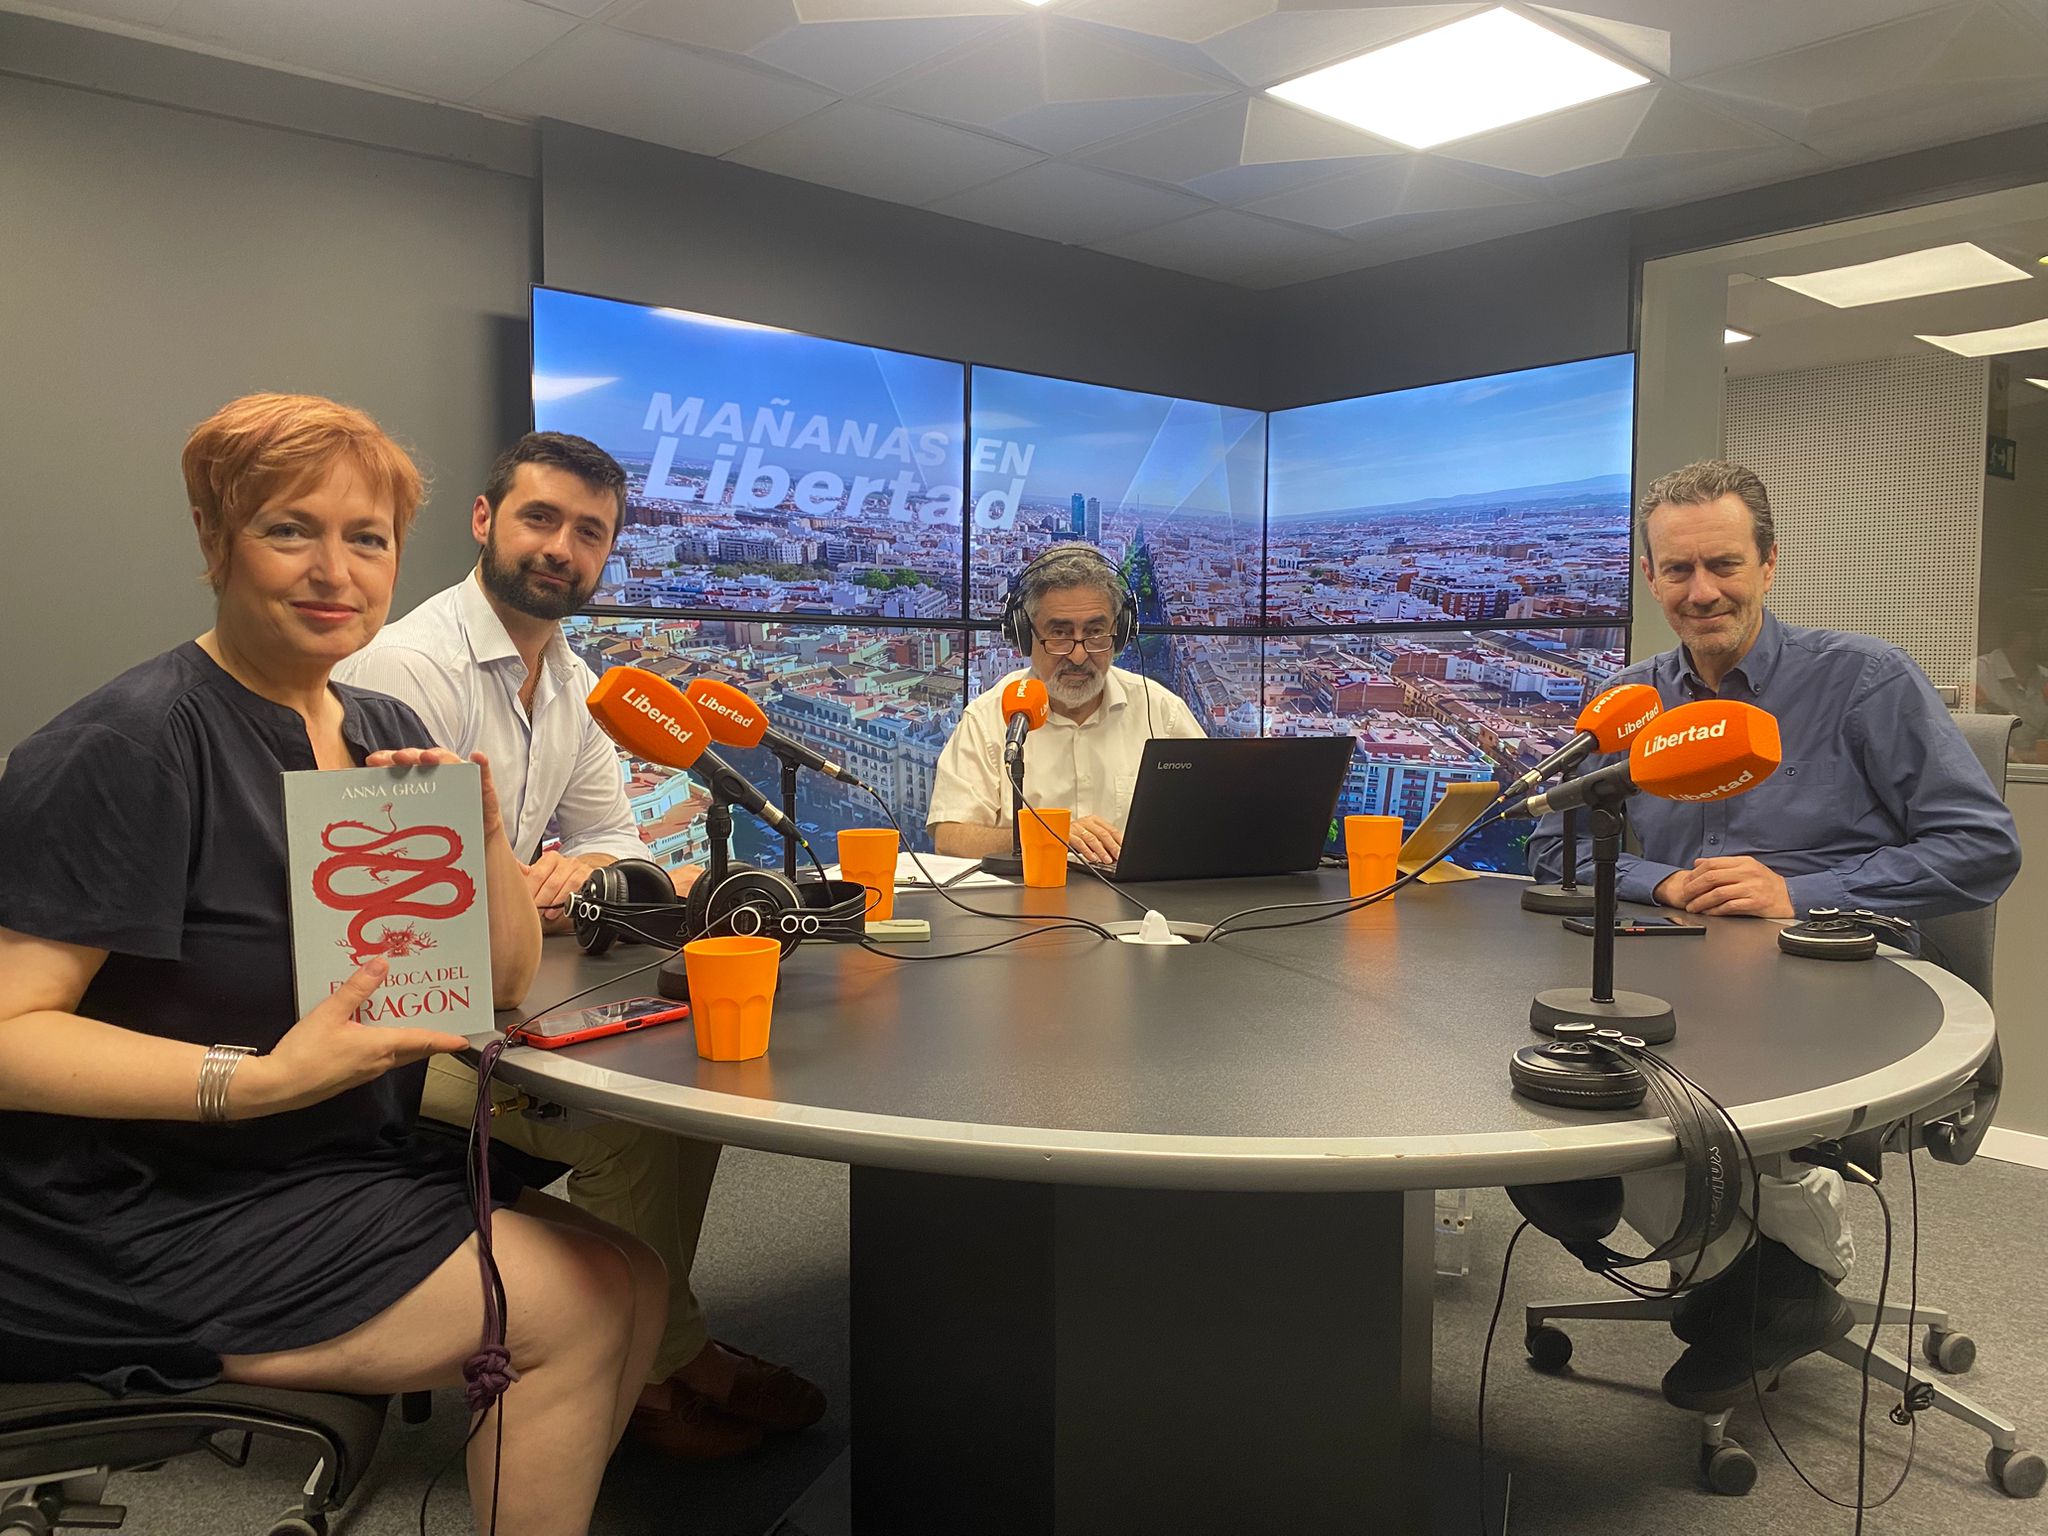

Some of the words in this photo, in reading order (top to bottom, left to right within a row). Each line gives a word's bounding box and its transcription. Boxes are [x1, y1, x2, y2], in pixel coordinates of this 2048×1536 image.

[643, 391, 949, 466] MAÑANAS
[972, 437, 1036, 476] EN
[643, 435, 1026, 531] Libertad
[622, 687, 693, 743] Libertad
[697, 693, 754, 728] Libertad
[1617, 702, 1659, 739] Libertad
[1643, 719, 1727, 757] Libertad
[1157, 761, 1193, 770] Lenovo
[341, 783, 387, 800] ANNA
[392, 781, 437, 796] GRAU
[384, 970, 433, 988] BOCA
[436, 965, 469, 981] DEL
